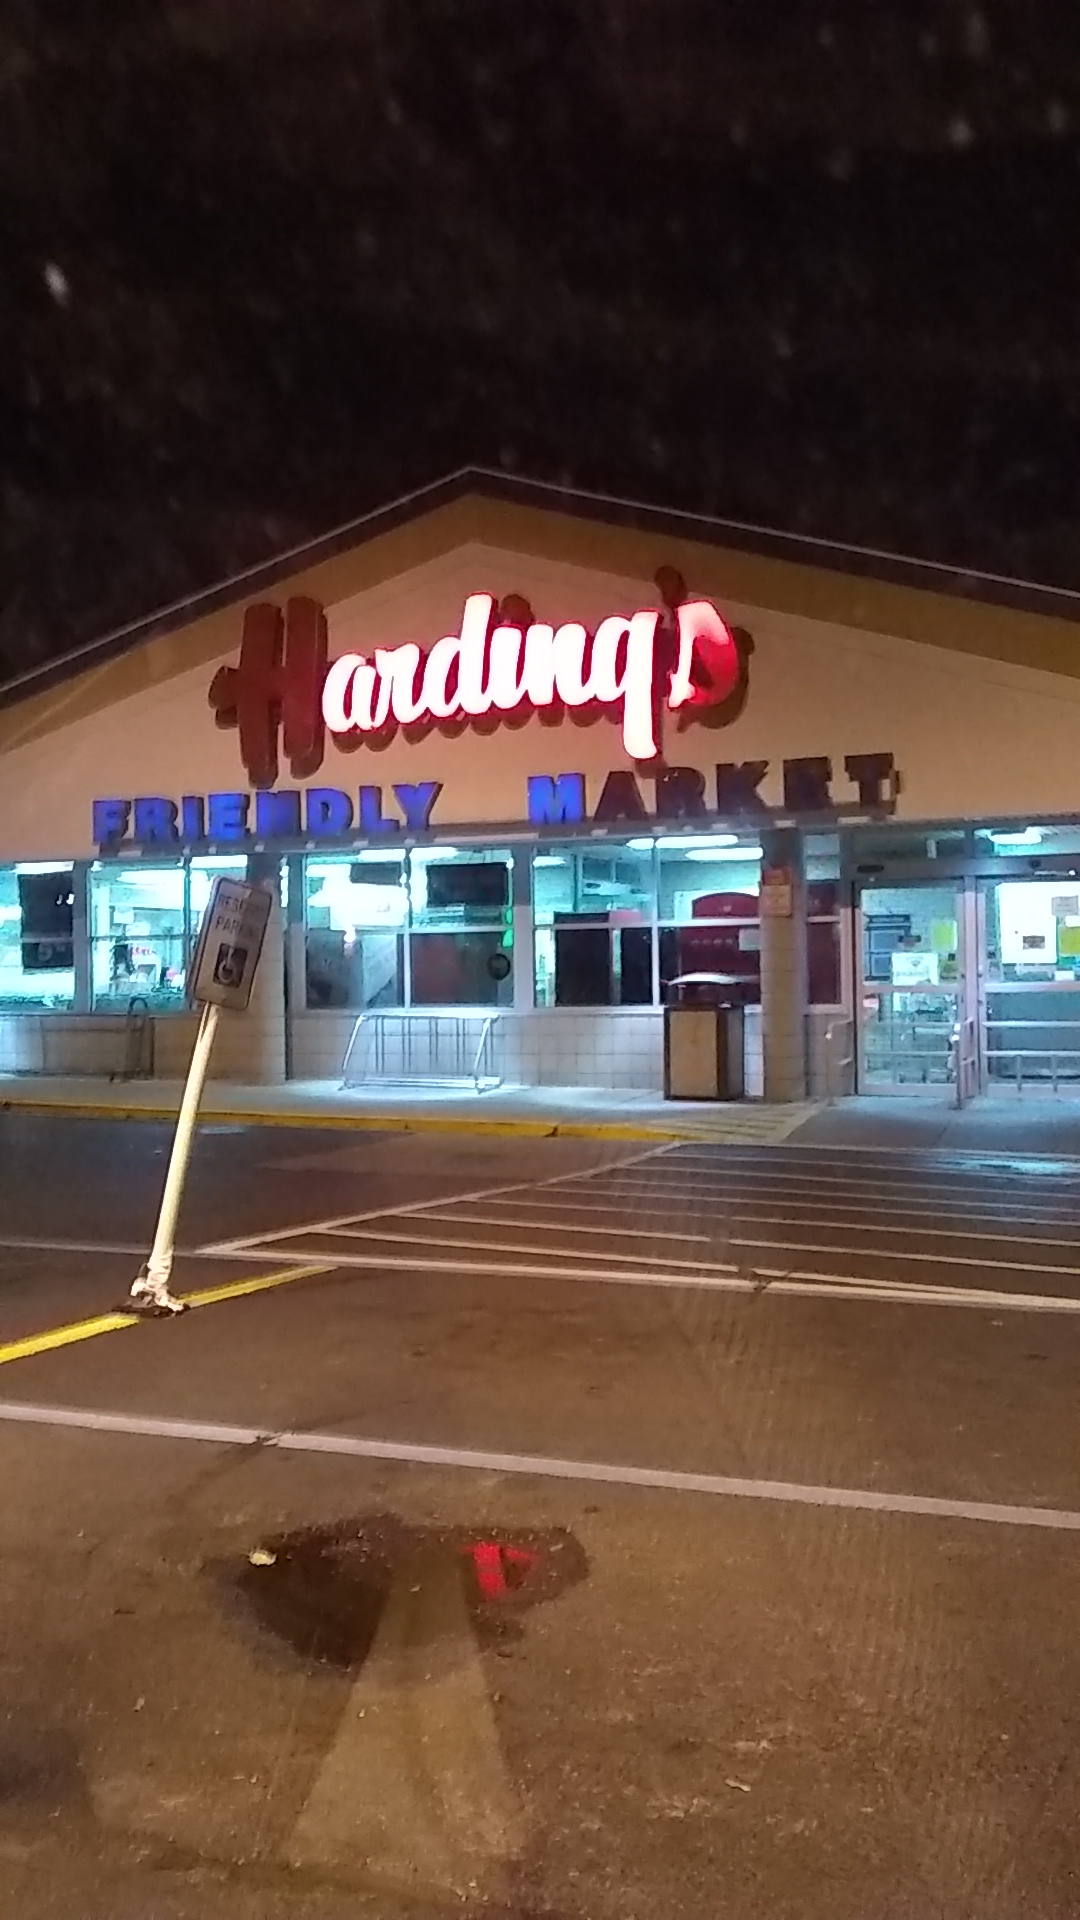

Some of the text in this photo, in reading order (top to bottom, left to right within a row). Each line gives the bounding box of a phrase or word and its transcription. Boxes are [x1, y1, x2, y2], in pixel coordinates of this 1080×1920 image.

[208, 566, 754, 788] Harding's
[92, 752, 900, 847] FRIENDLY MARKET
[218, 895, 266, 916] RESE
